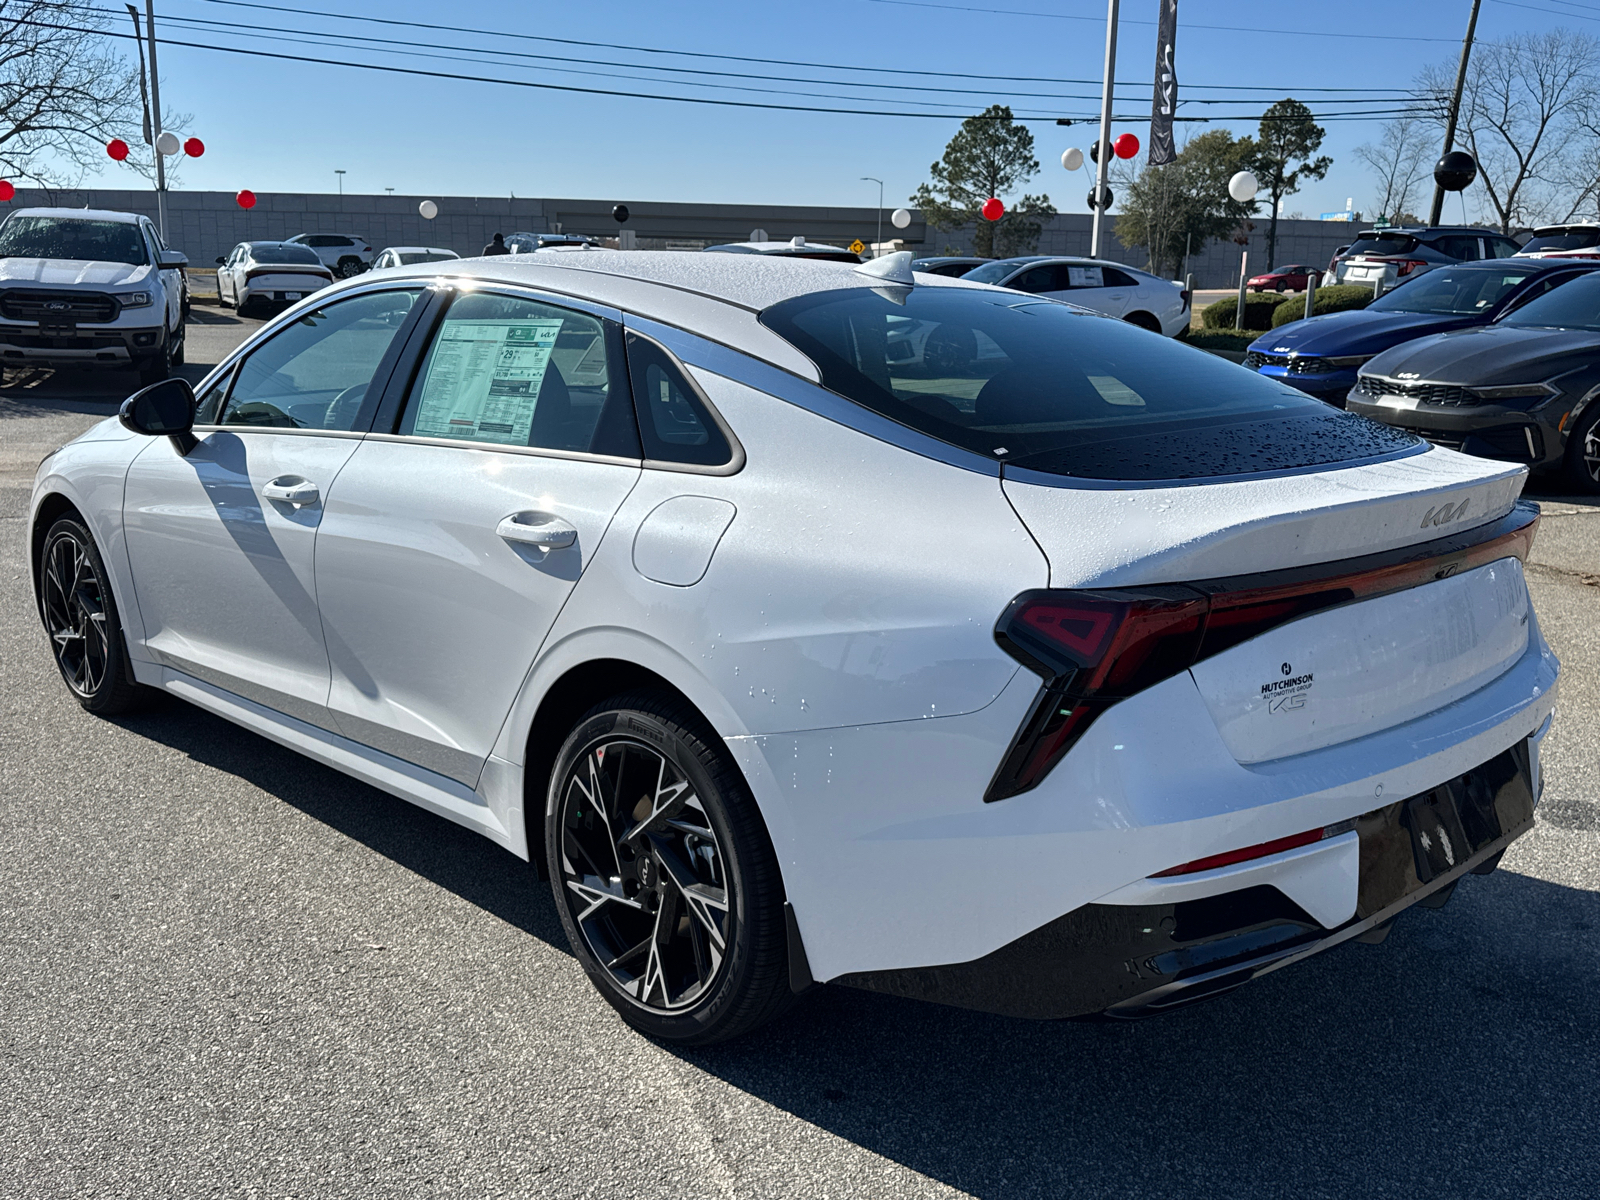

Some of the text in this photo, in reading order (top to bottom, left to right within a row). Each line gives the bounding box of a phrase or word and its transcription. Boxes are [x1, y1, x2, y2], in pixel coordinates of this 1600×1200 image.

[504, 350, 513, 358] 29
[1421, 497, 1470, 528] KIA
[1261, 673, 1314, 694] HUTCHINSON
[1263, 683, 1313, 700] AUTOMOTIVE GROUP
[1269, 693, 1307, 715] K5
[627, 716, 665, 744] PIRELLI
